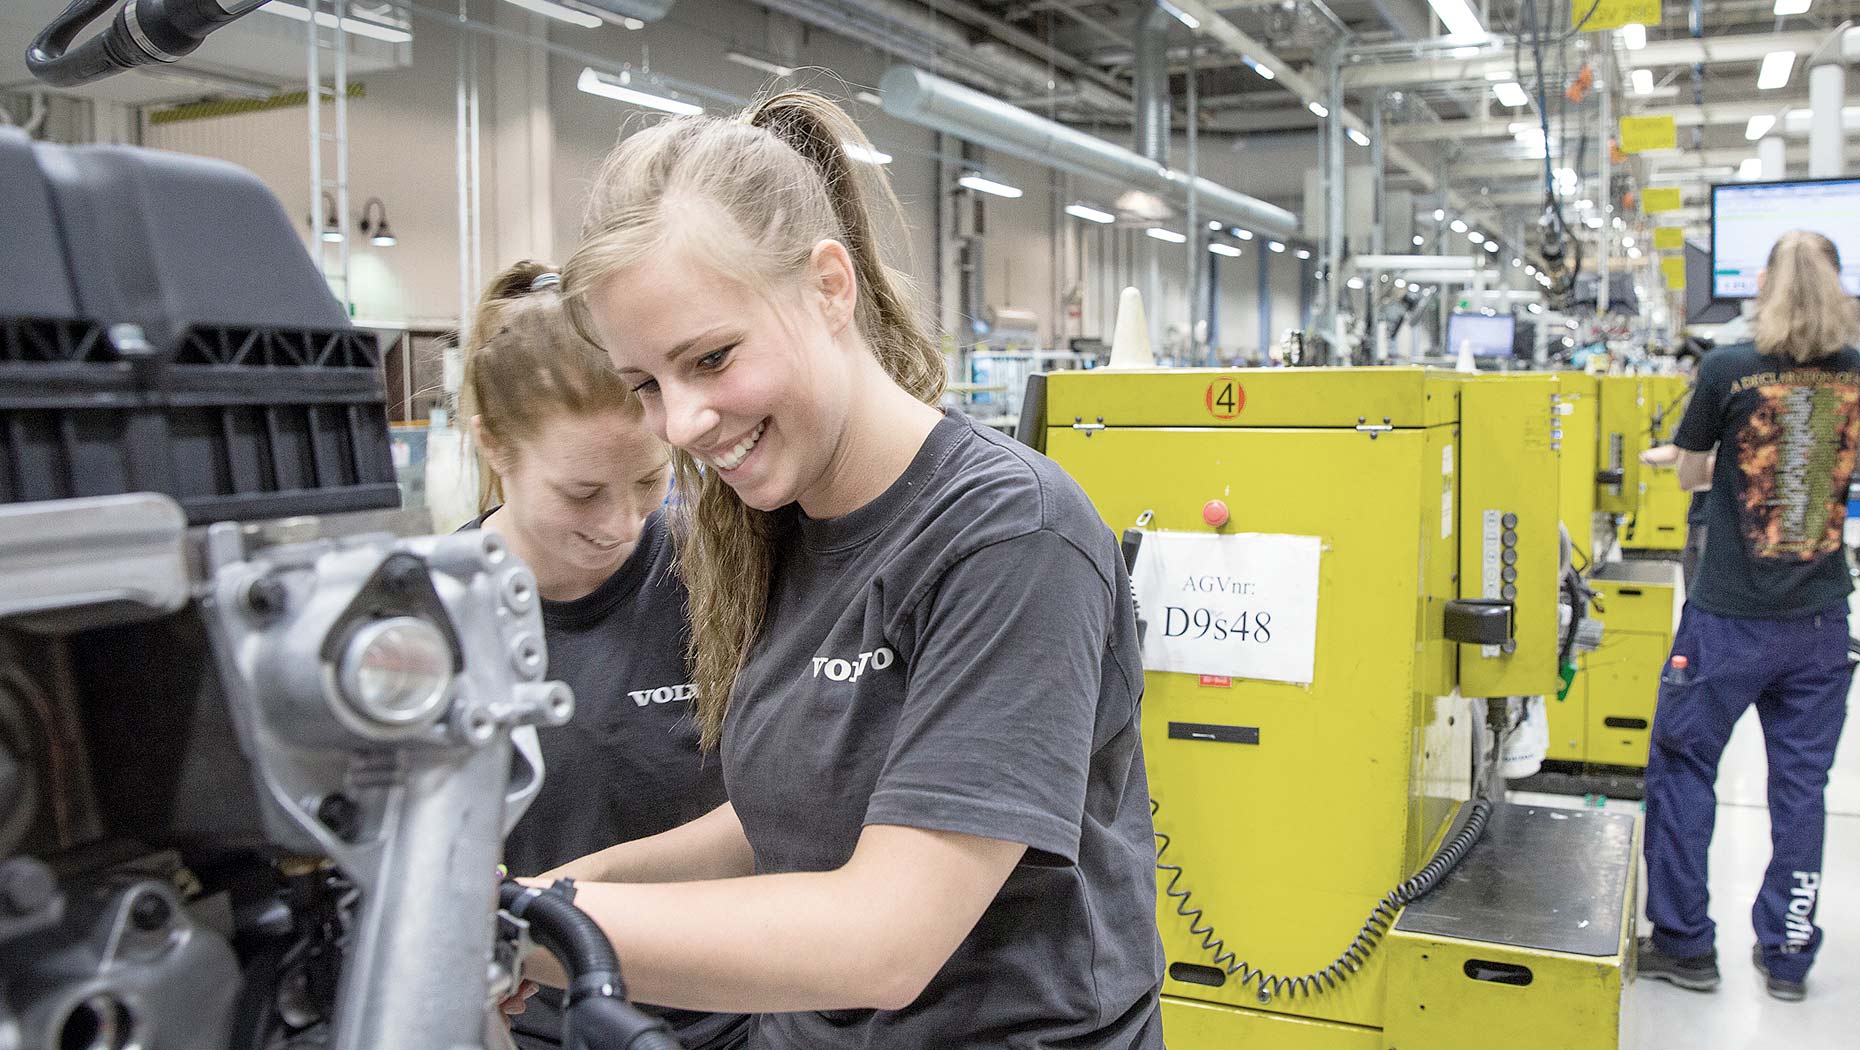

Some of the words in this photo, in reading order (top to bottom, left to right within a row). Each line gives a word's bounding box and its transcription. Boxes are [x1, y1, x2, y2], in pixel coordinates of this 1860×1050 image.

[1216, 383, 1235, 413] 4
[1182, 575, 1256, 596] AGVnr:
[1163, 606, 1271, 644] D9s48
[627, 683, 701, 708] VOL
